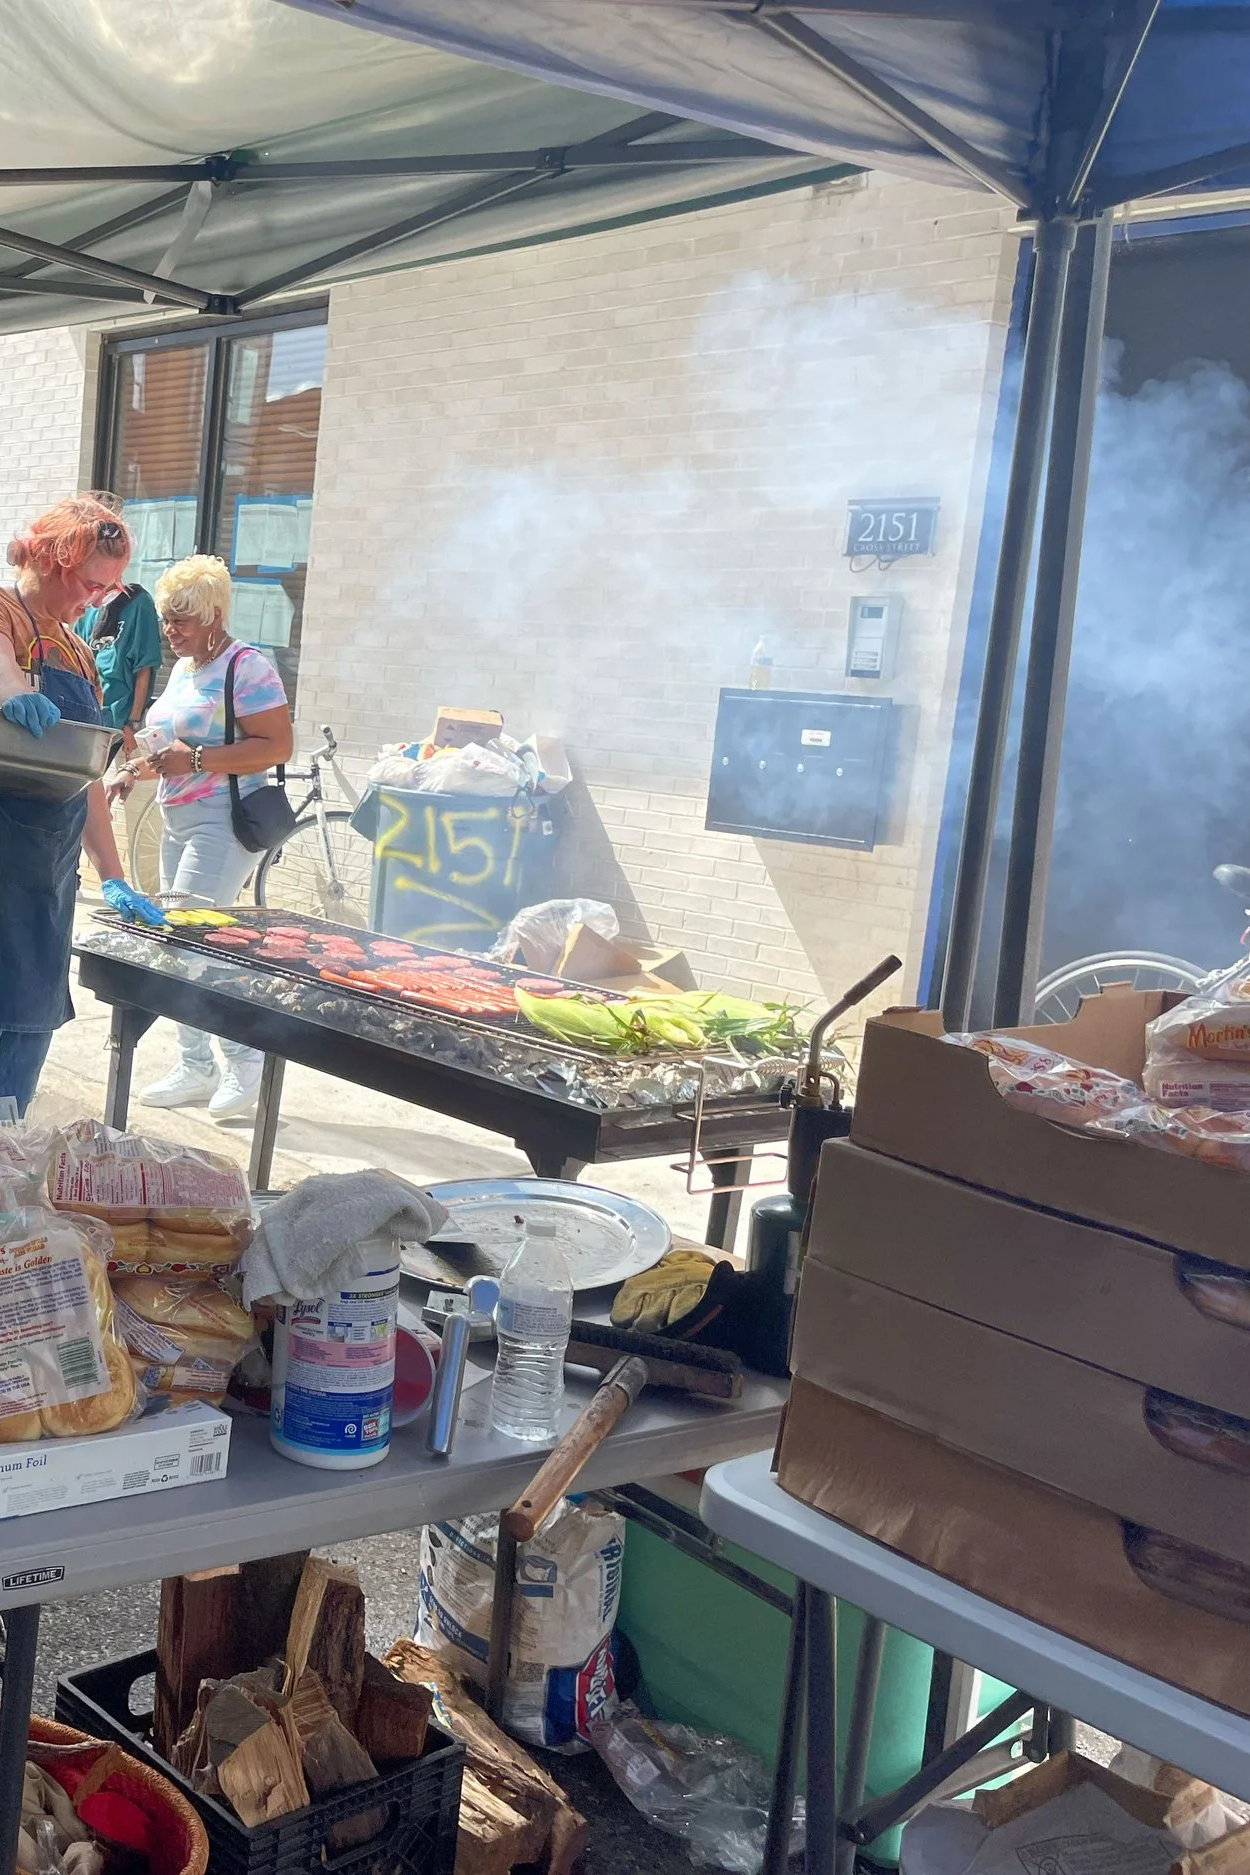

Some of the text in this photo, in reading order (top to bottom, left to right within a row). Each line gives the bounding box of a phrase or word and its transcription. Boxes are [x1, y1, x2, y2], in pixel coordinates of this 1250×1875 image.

[858, 512, 918, 541] 2151
[374, 793, 525, 887] 2151
[1162, 1083, 1203, 1091] Nutrition
[56, 1152, 67, 1200] Nutrition Facts
[15, 1264, 22, 1273] is
[24, 1256, 53, 1269] Golden
[293, 1298, 323, 1317] Lysol
[25, 1454, 47, 1469] Foil
[10, 1570, 57, 1586] LIFETIME
